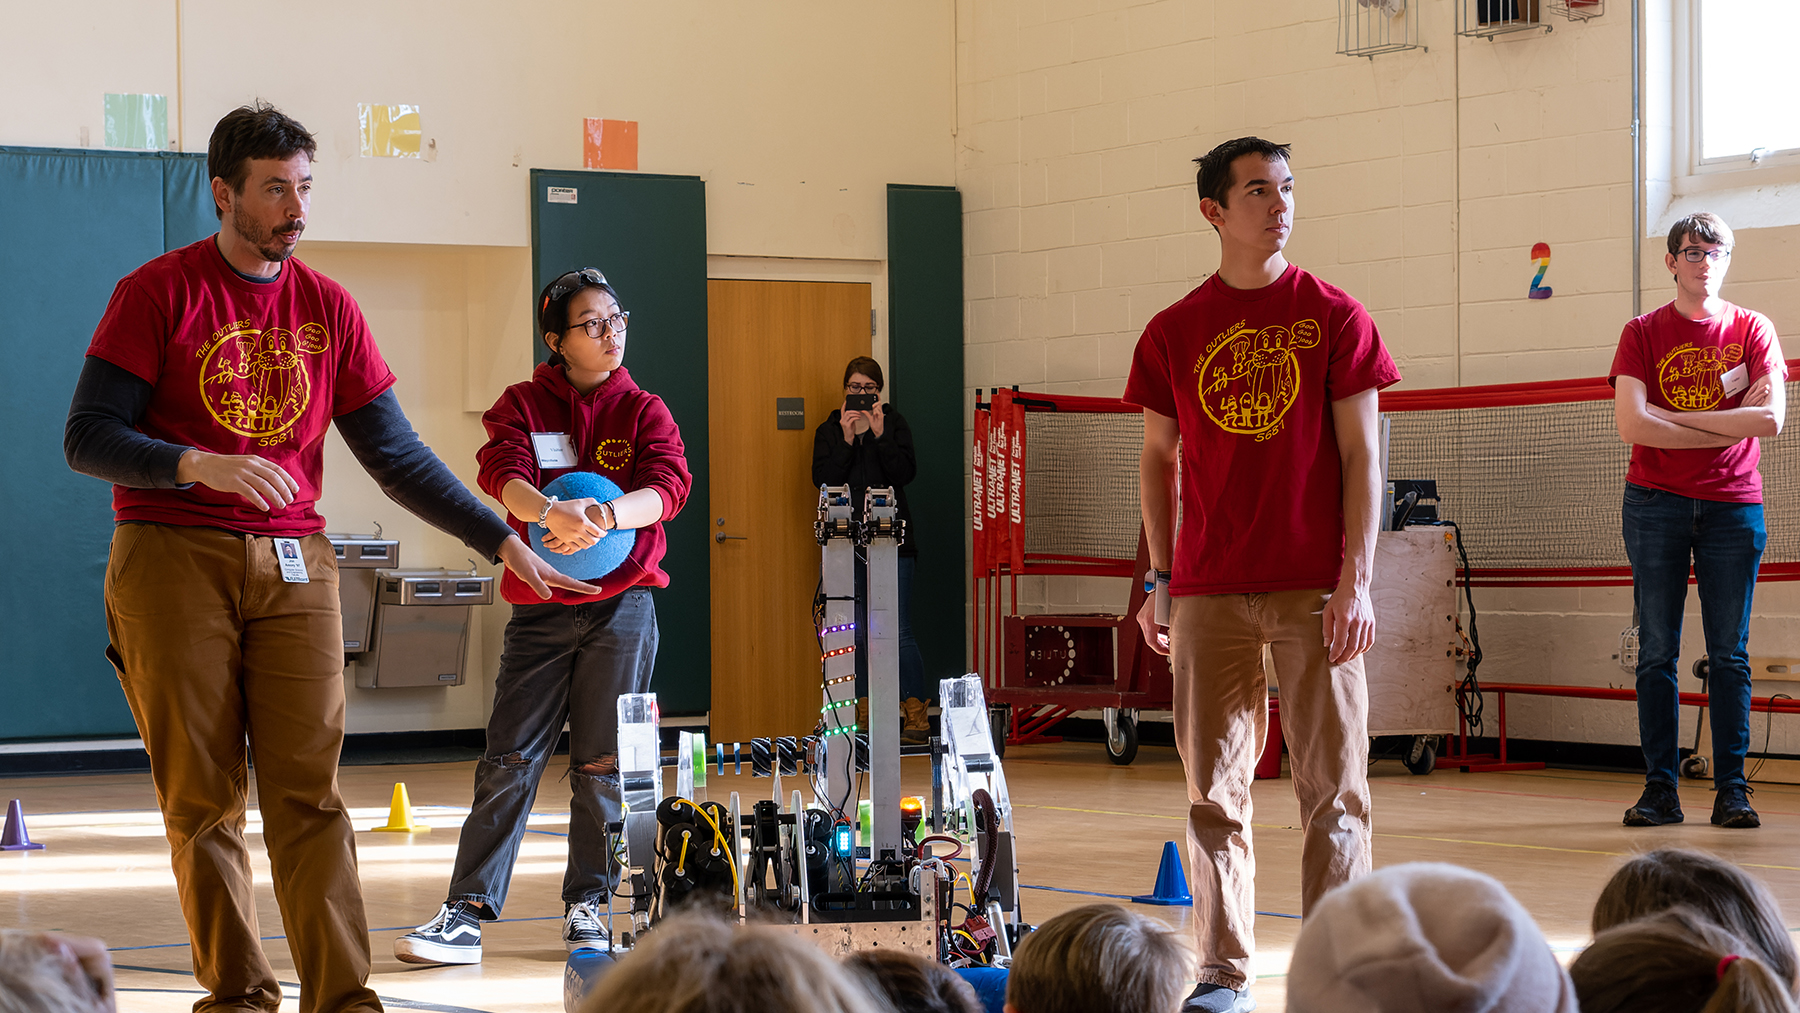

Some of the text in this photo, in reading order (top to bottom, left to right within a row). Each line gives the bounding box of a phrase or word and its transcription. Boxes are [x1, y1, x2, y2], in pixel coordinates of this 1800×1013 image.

[1528, 242, 1553, 299] 2
[305, 326, 321, 334] Goo
[1297, 329, 1312, 337] Goo
[1298, 322, 1315, 330] Goo
[195, 318, 251, 359] THE OUTLIERS
[305, 333, 320, 342] Goo
[1193, 319, 1246, 374] THE OUTLIERS
[1656, 341, 1693, 369] THE OUTLIERS
[258, 427, 294, 447] 5687
[1254, 419, 1285, 442] 5687
[595, 446, 633, 458] OUTLIERS
